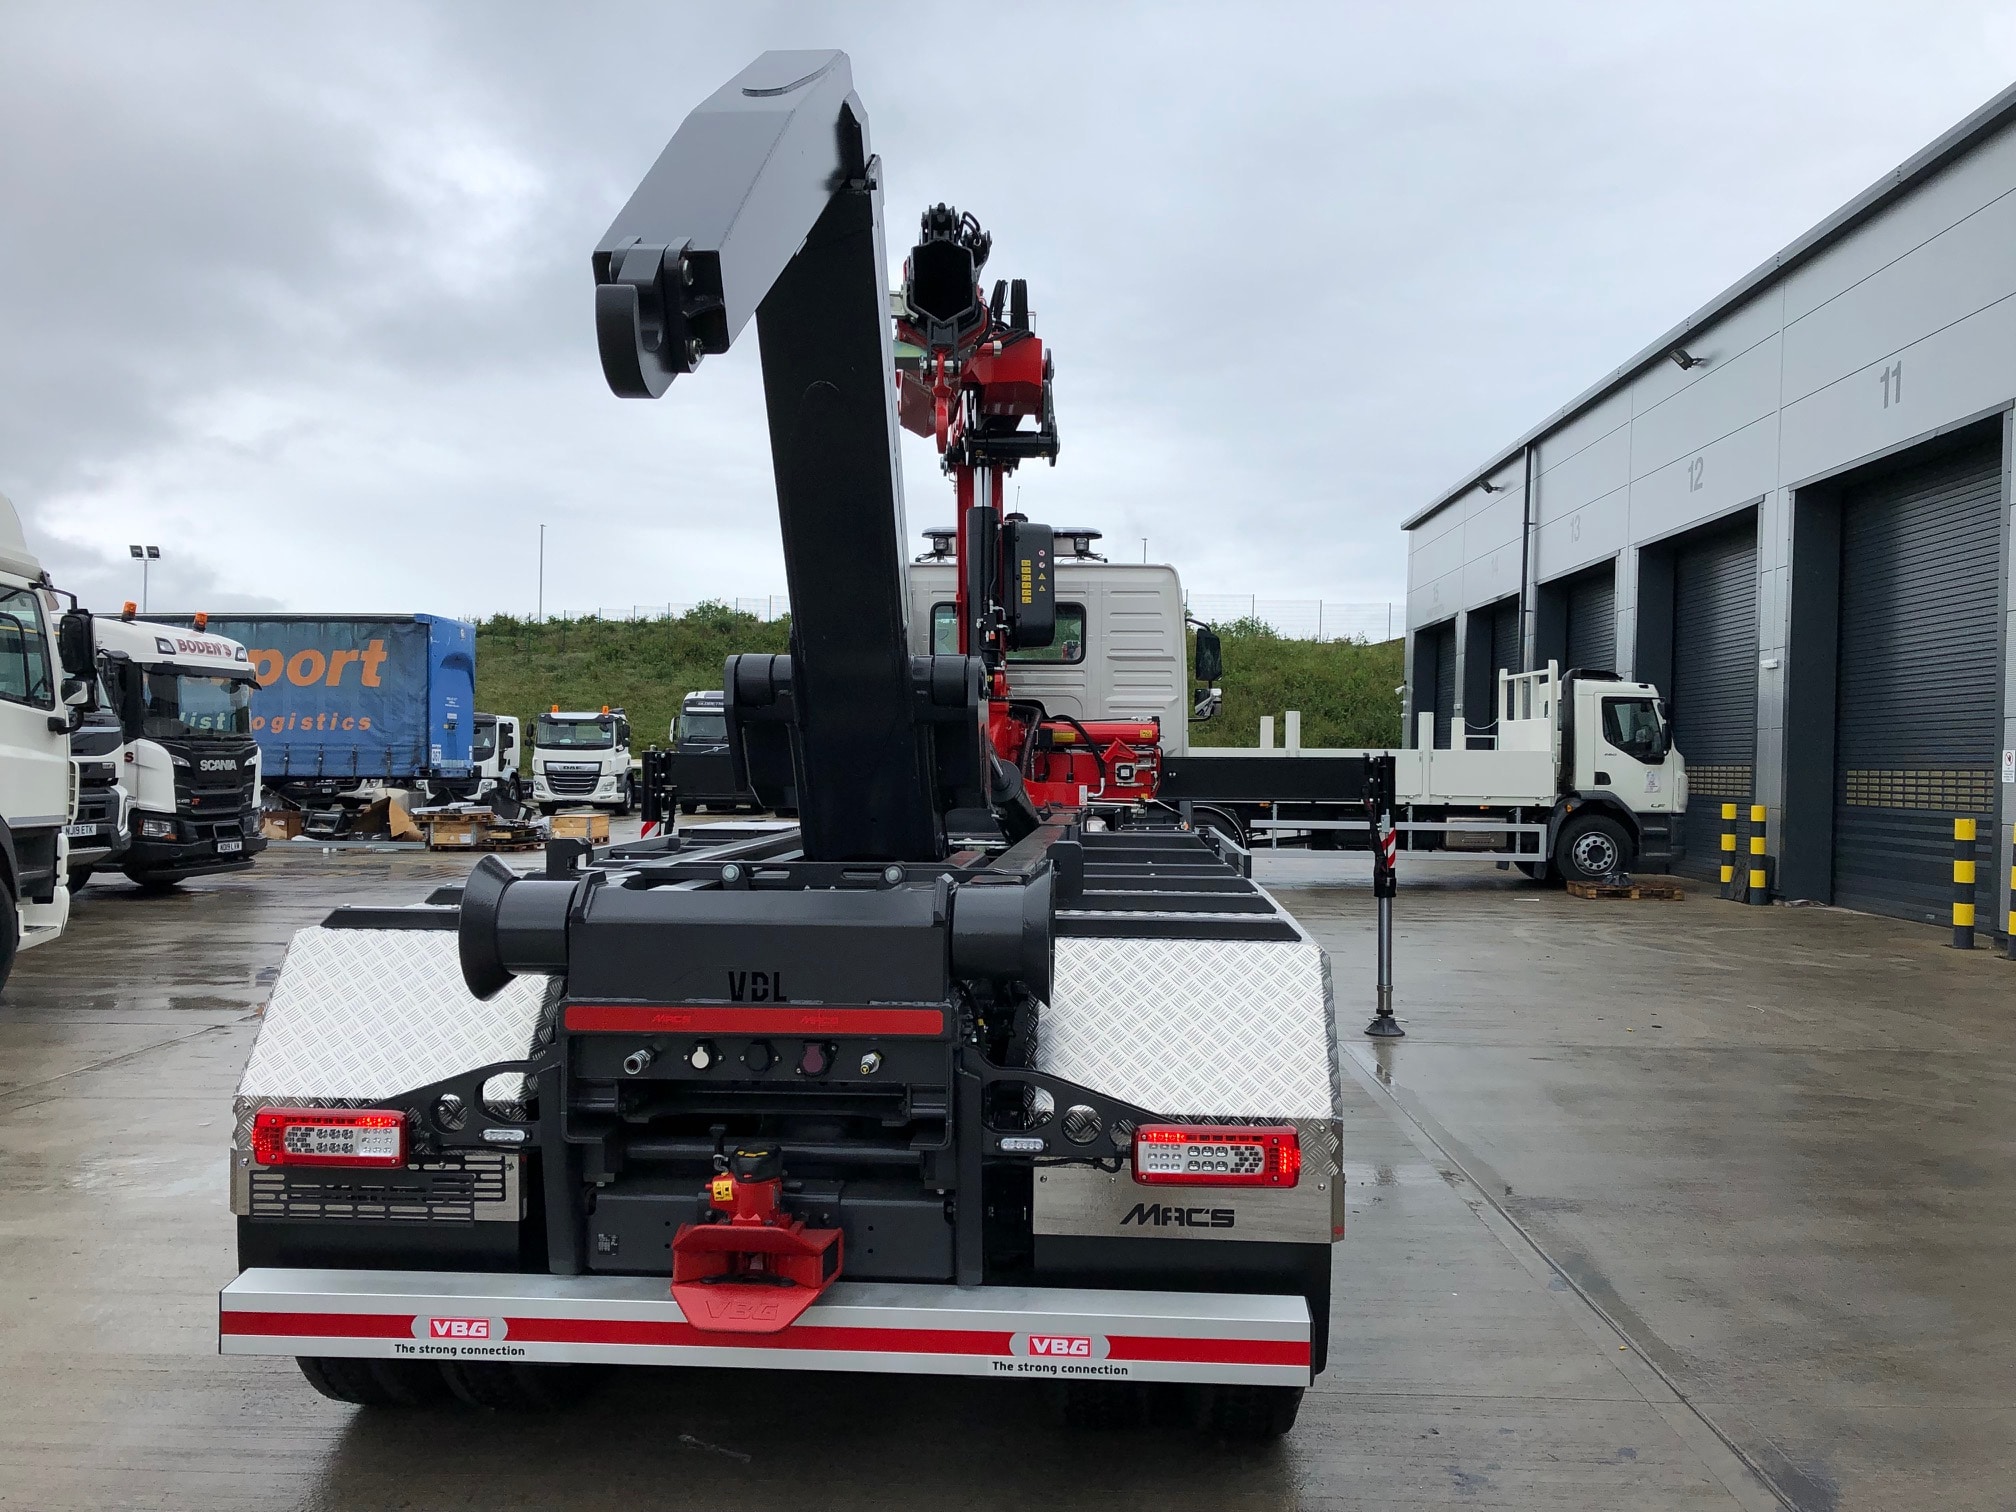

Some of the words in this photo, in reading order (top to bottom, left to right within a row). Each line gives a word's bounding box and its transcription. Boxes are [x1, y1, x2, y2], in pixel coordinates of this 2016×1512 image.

[1880, 360, 1902, 409] 11
[1687, 456, 1704, 492] 12
[1570, 514, 1581, 544] 13
[175, 638, 232, 658] BODEN'S
[247, 639, 388, 689] port
[200, 759, 237, 771] SCANIA
[81, 825, 93, 834] ETK
[728, 971, 787, 1002] VDL
[705, 1300, 779, 1321] VBG
[433, 1321, 487, 1337] VBG
[394, 1344, 415, 1353] The
[419, 1345, 457, 1356] strong
[461, 1346, 525, 1356] connection
[1031, 1338, 1089, 1355] VBG
[992, 1361, 1014, 1371] The
[1017, 1362, 1057, 1375] strong
[1061, 1364, 1128, 1375] connection
